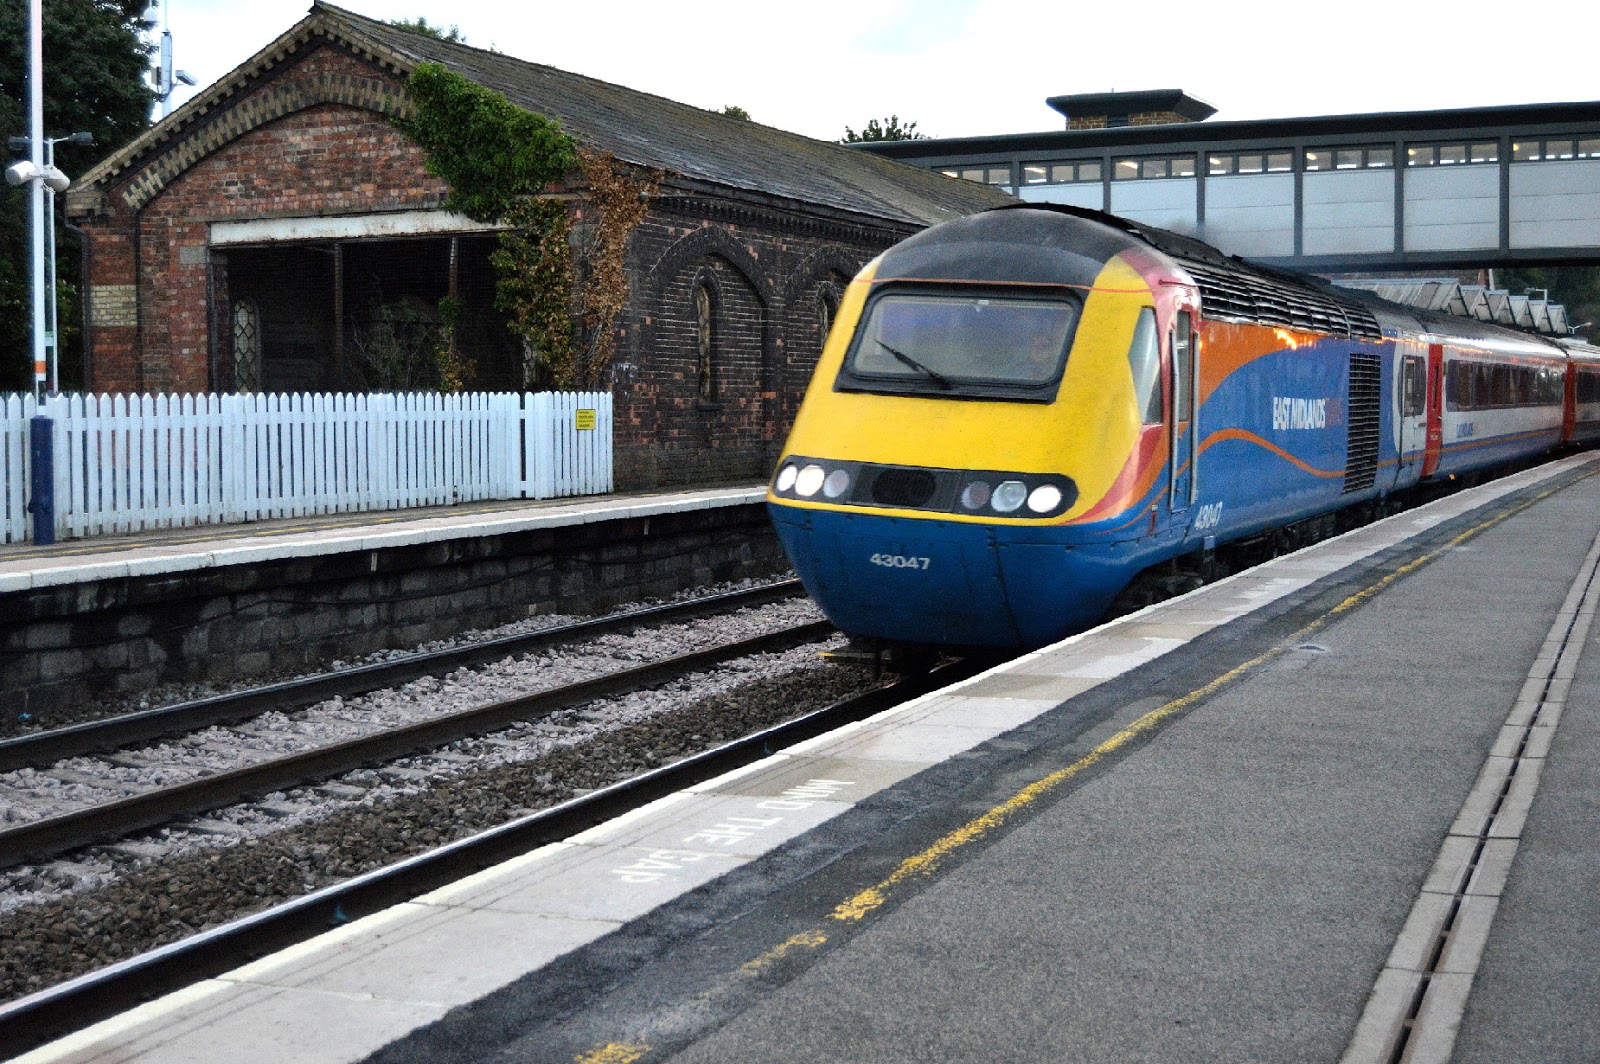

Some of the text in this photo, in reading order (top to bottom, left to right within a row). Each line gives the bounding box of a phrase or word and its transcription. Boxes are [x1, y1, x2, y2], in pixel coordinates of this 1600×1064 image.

[1272, 397, 1291, 431] EAST
[1291, 397, 1326, 430] MIDLANDS
[1194, 501, 1223, 531] 43047
[869, 553, 931, 570] 43047
[611, 779, 856, 883] MIND THE GAP
